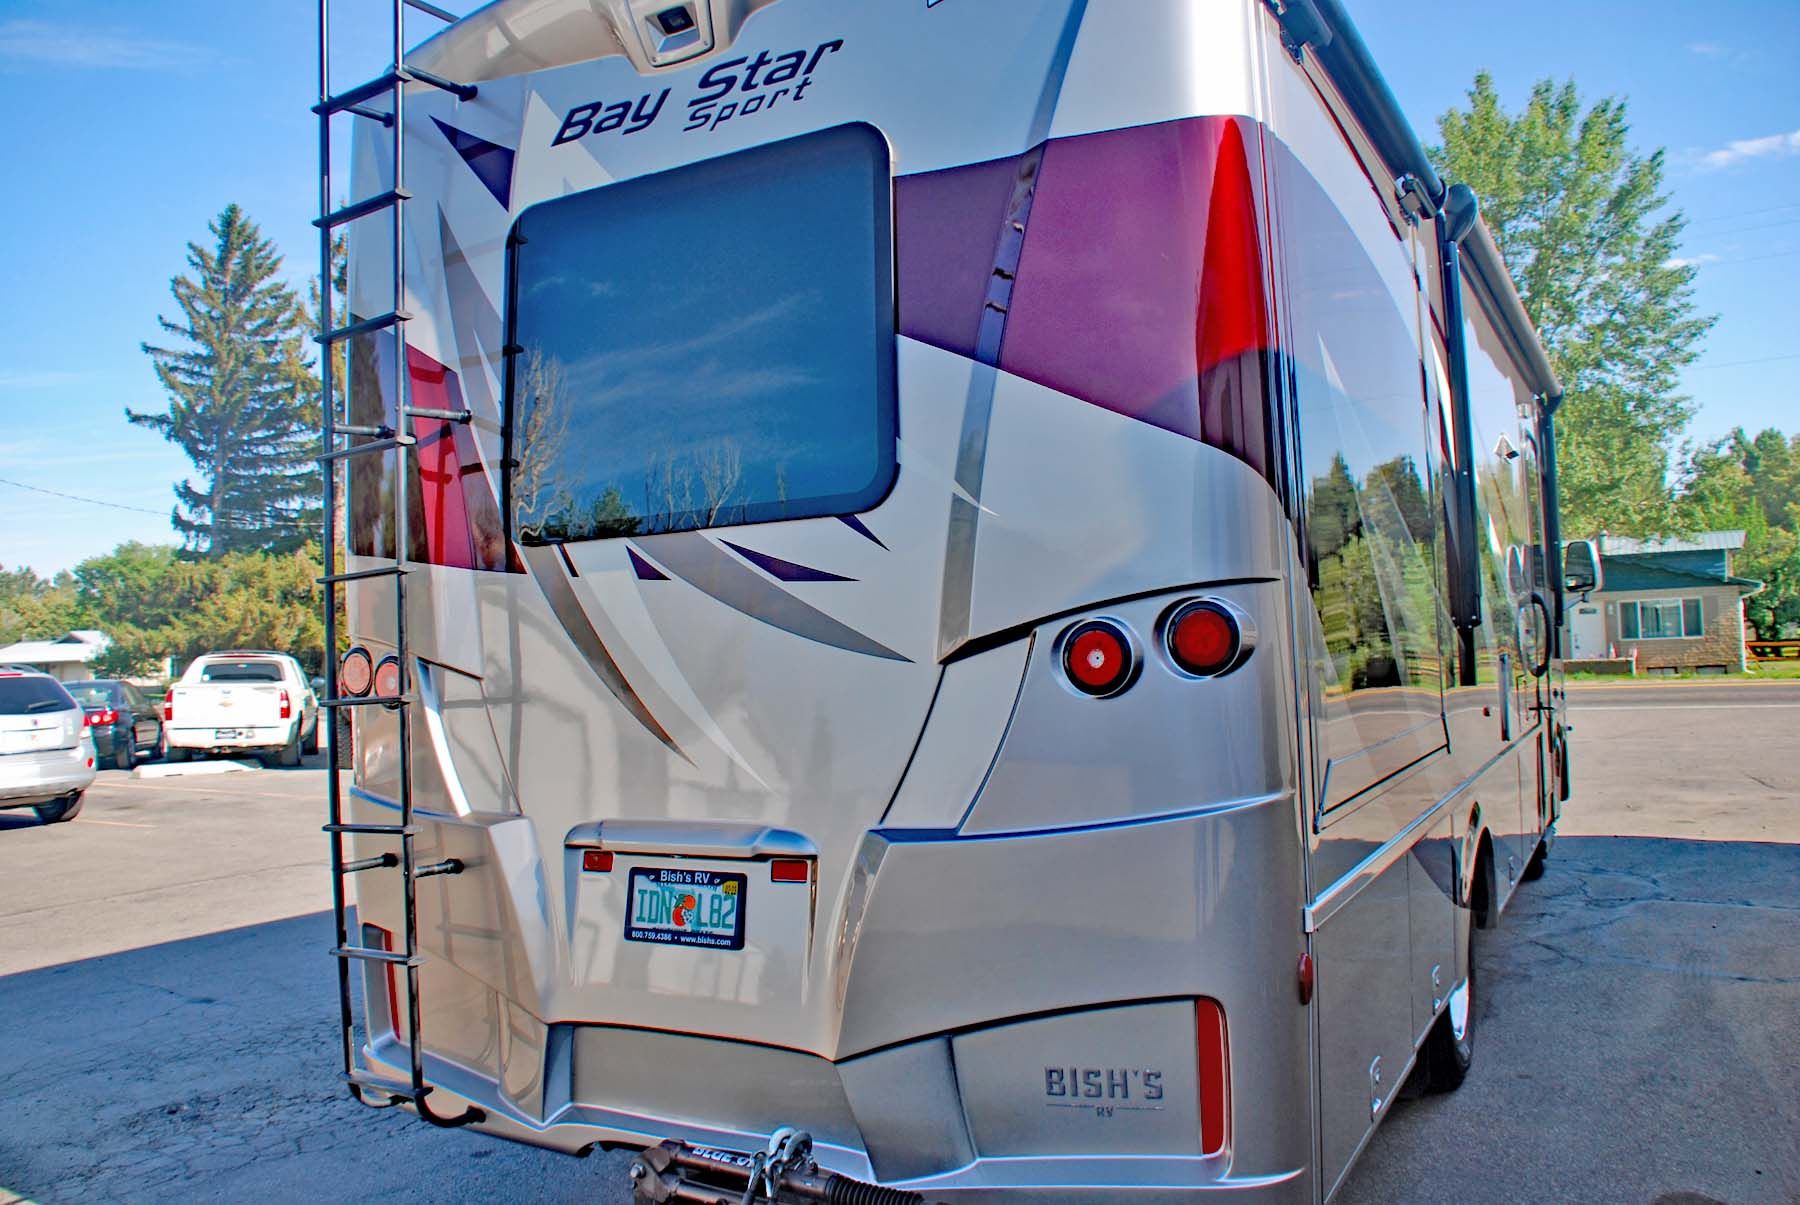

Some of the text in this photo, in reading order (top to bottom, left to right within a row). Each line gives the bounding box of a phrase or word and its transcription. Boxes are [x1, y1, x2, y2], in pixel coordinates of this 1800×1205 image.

[551, 39, 844, 147] Bay Star
[683, 77, 812, 132] Sport
[660, 870, 711, 884] Bish's RV
[635, 889, 674, 925] IDN
[680, 935, 731, 946] www.bishs.com
[1045, 1067, 1164, 1100] BISH'S
[1096, 1106, 1114, 1118] RV
